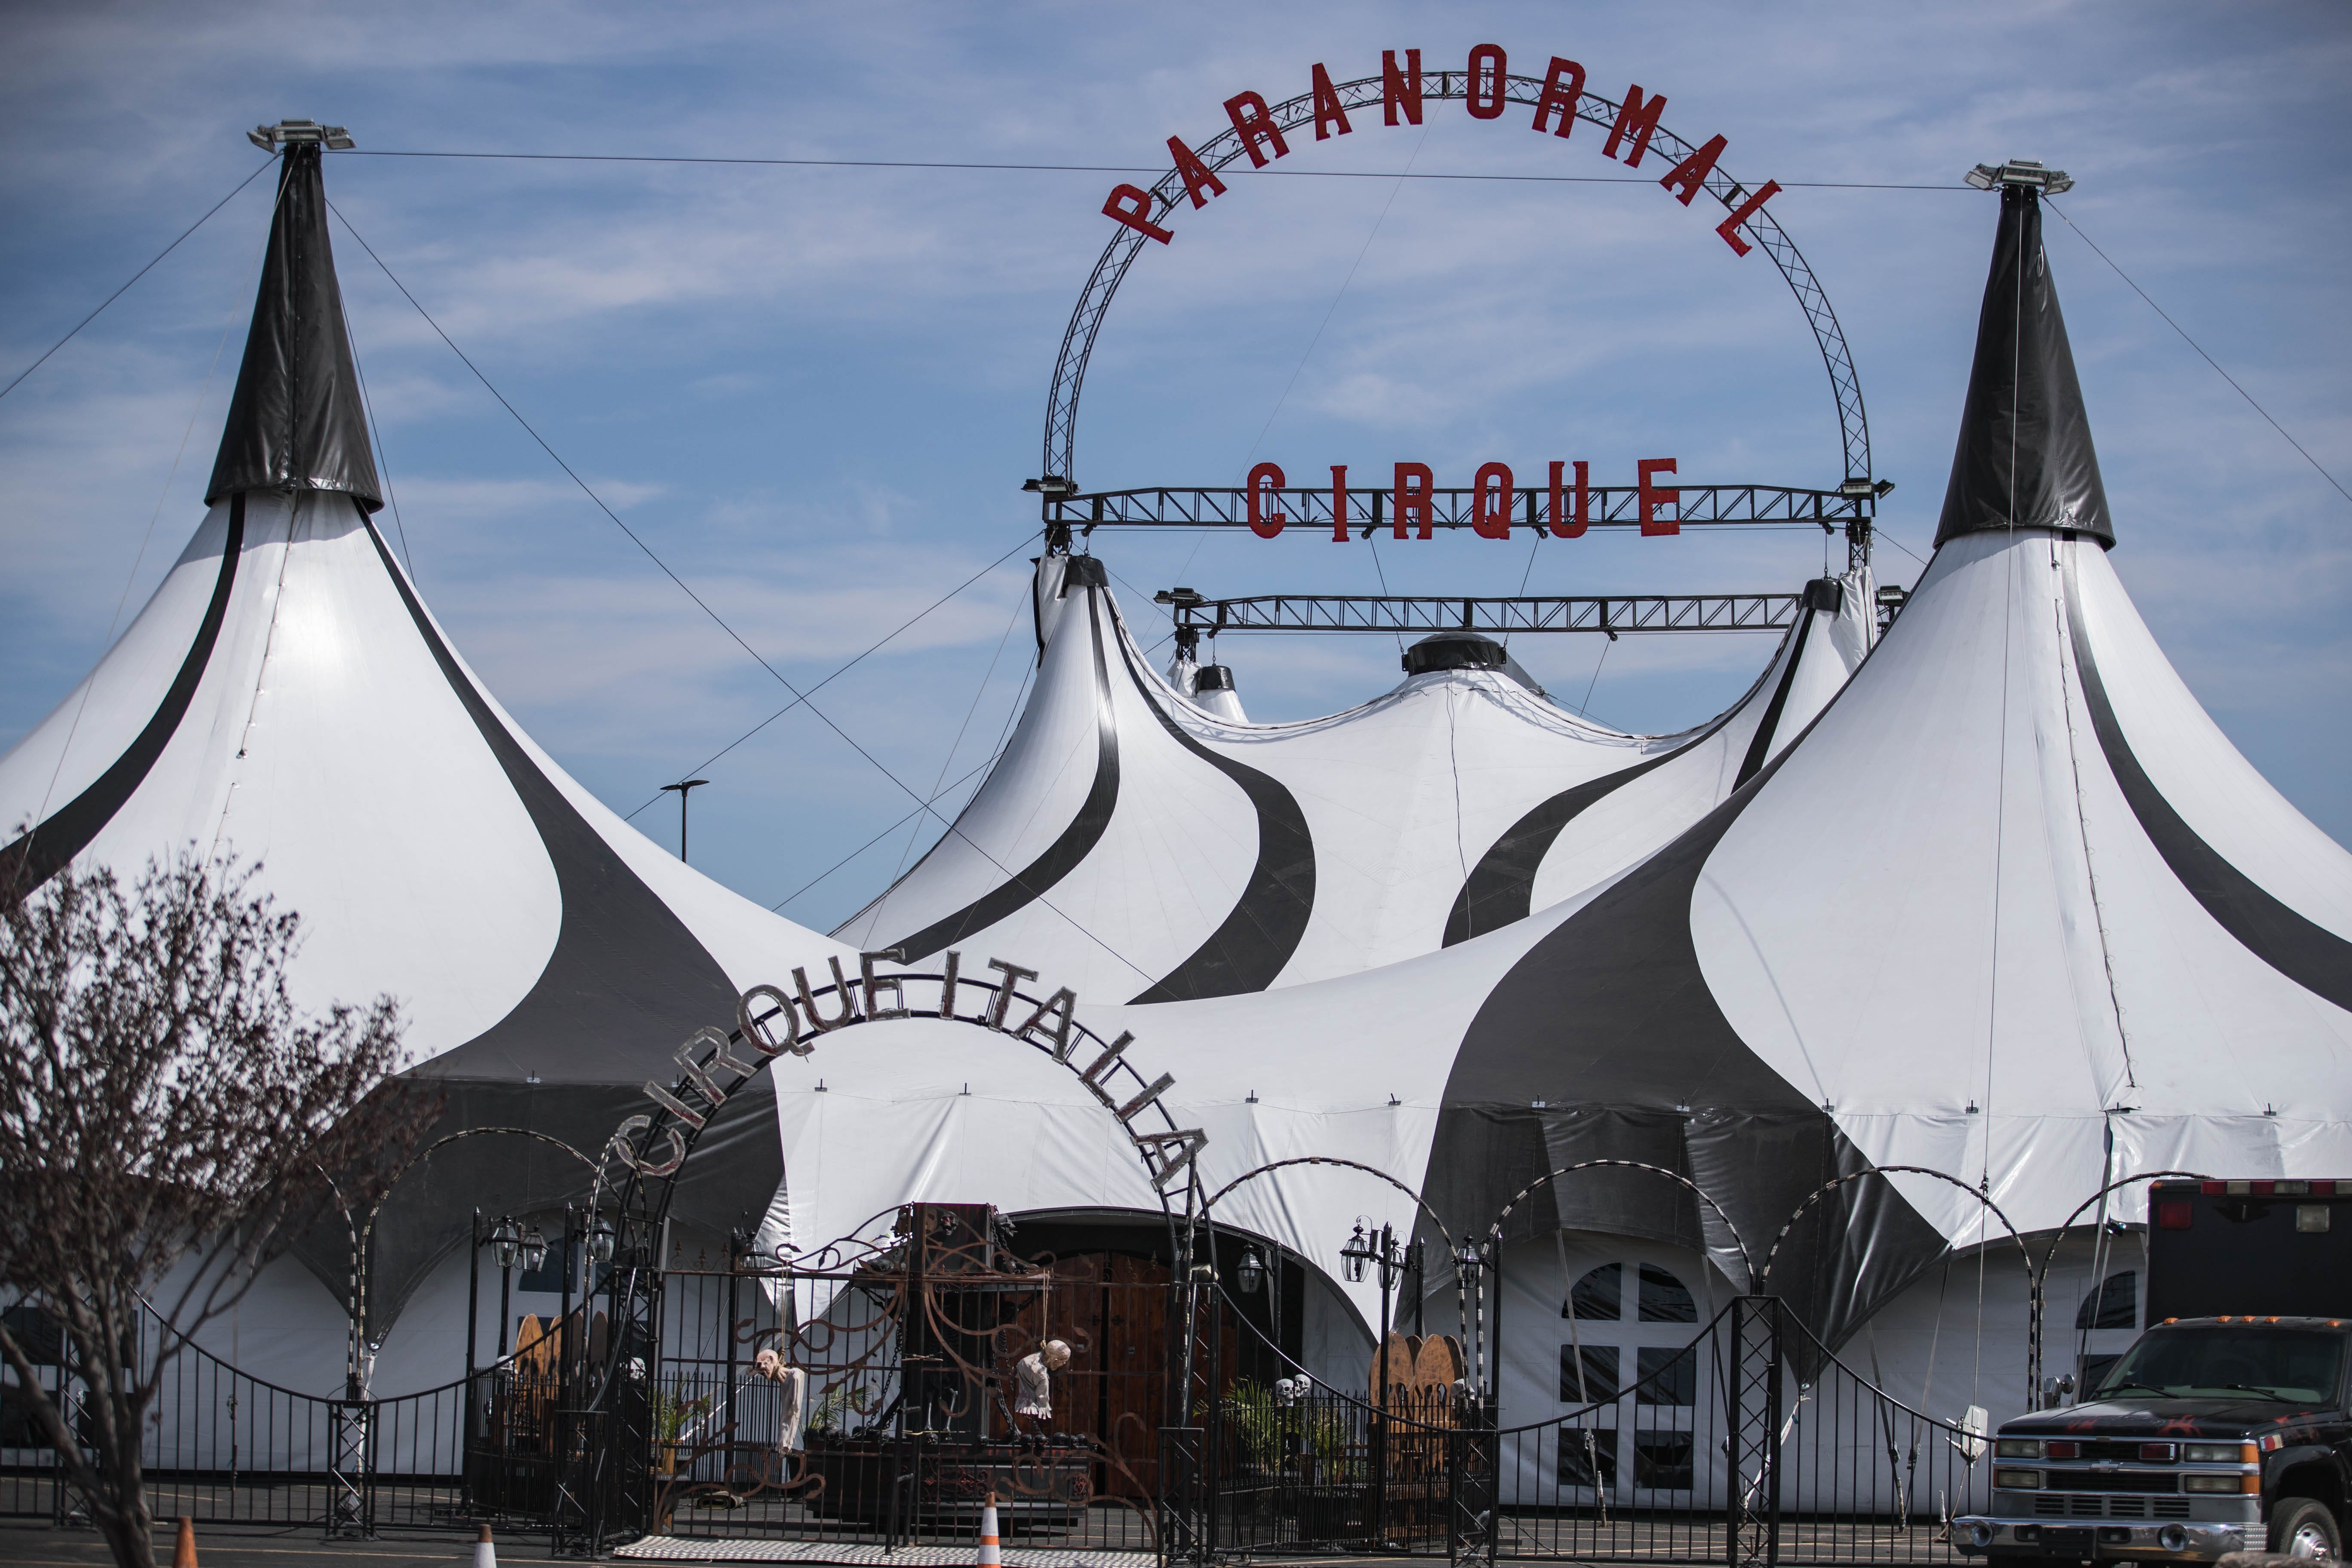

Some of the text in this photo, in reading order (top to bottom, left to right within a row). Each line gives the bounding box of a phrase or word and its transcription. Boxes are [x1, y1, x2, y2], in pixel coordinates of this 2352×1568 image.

[1102, 44, 1782, 257] PARANORMAL
[1247, 458, 1680, 542] CIRQUE
[615, 947, 1209, 1192] CIRQUE ITALIA
